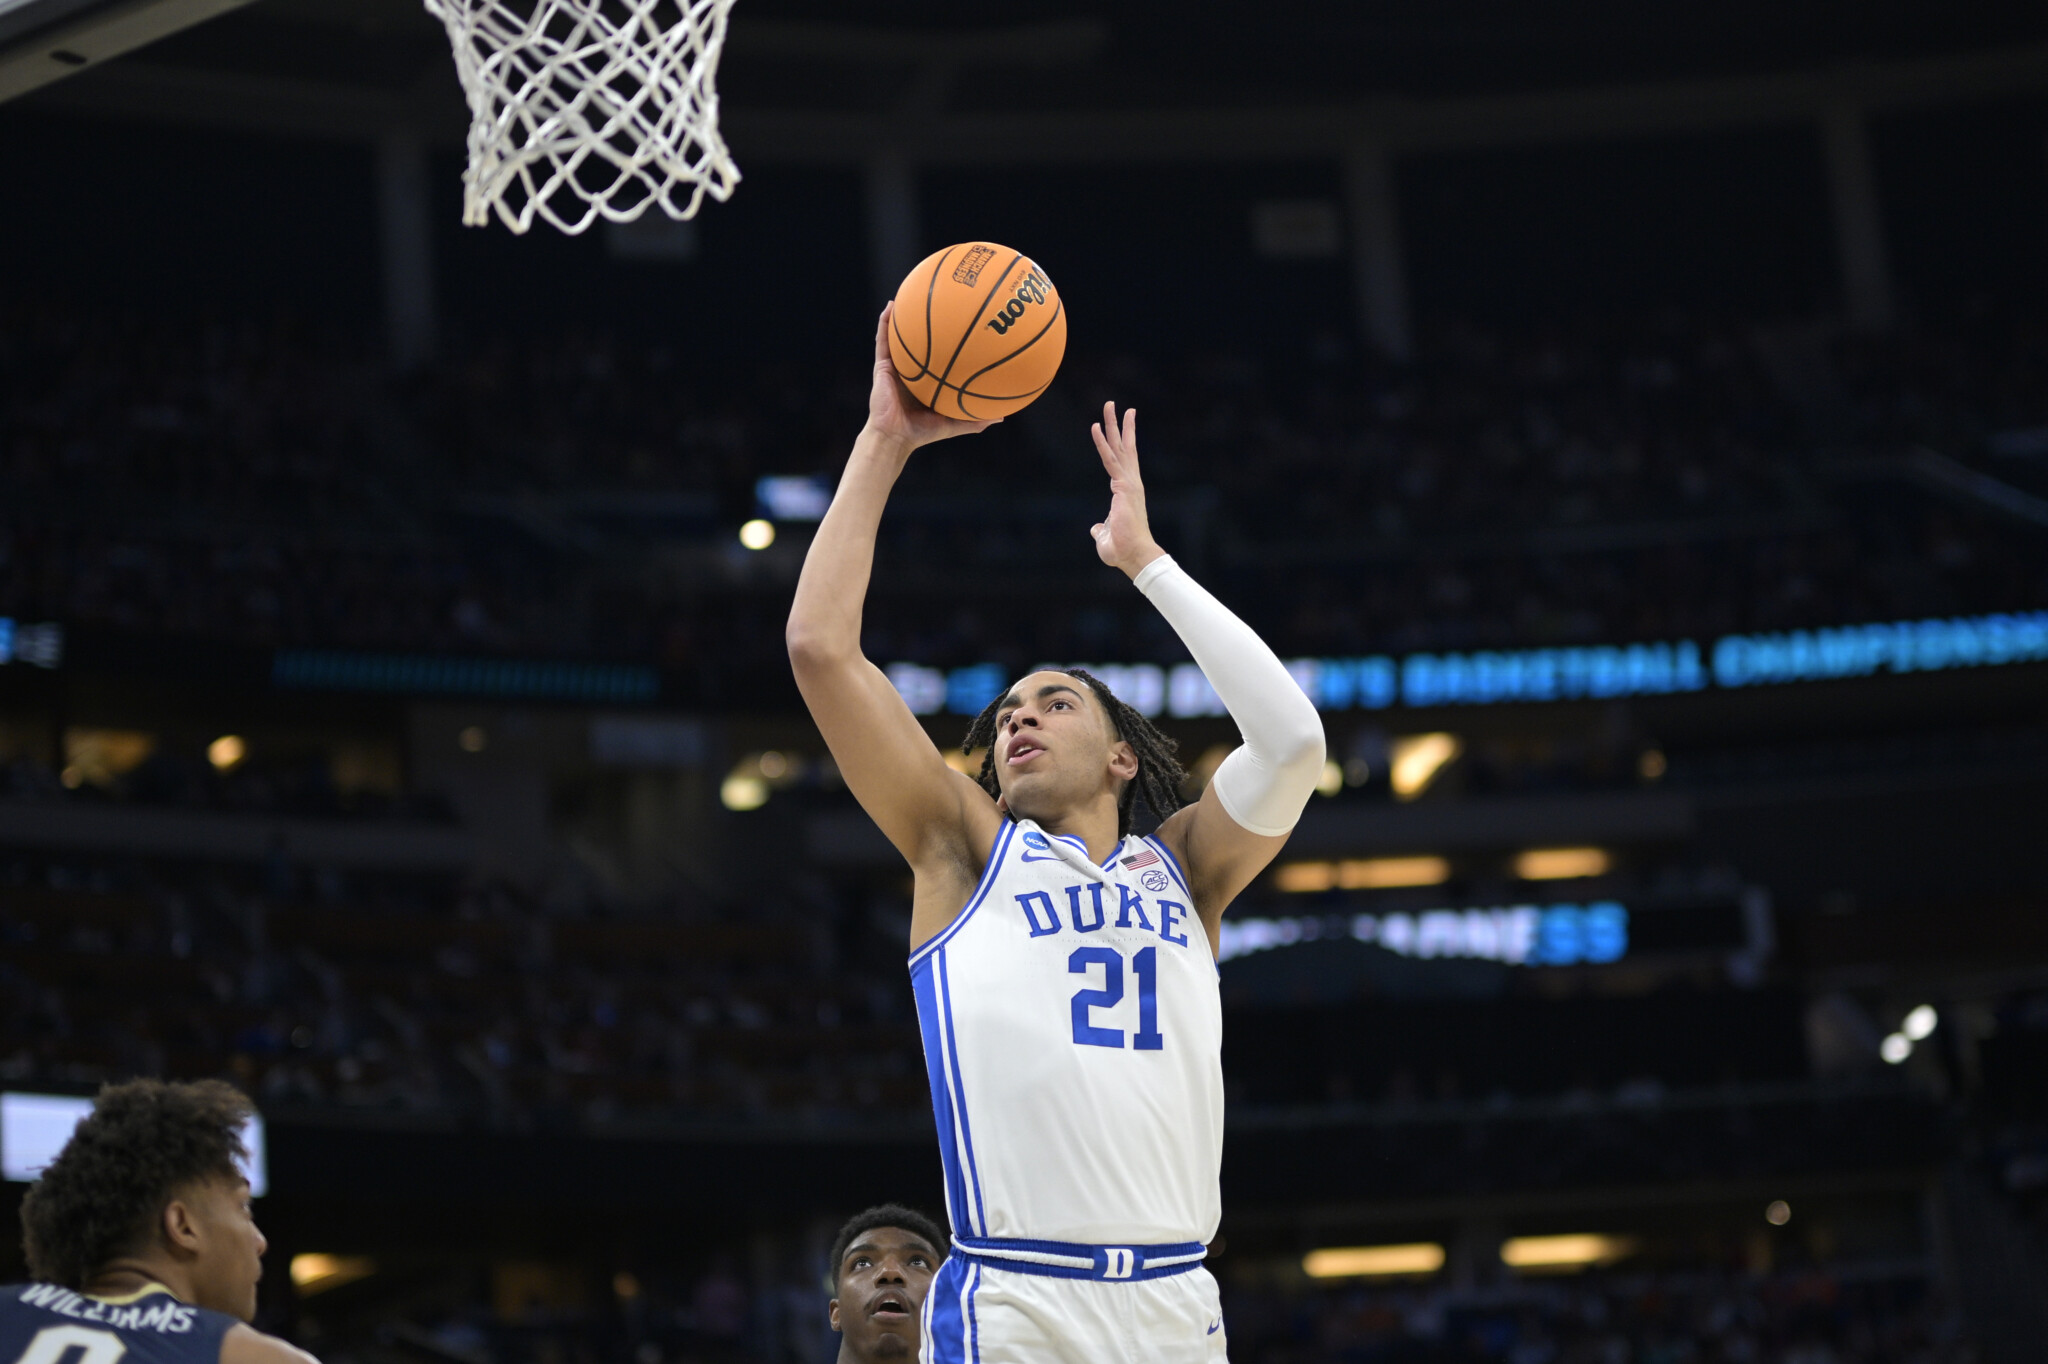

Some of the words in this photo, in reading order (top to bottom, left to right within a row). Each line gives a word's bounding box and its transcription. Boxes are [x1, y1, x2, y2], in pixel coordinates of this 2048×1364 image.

[1025, 836, 1049, 848] NCAA
[1146, 873, 1166, 885] ACC
[1014, 882, 1188, 949] DUKE
[1068, 946, 1163, 1051] 21
